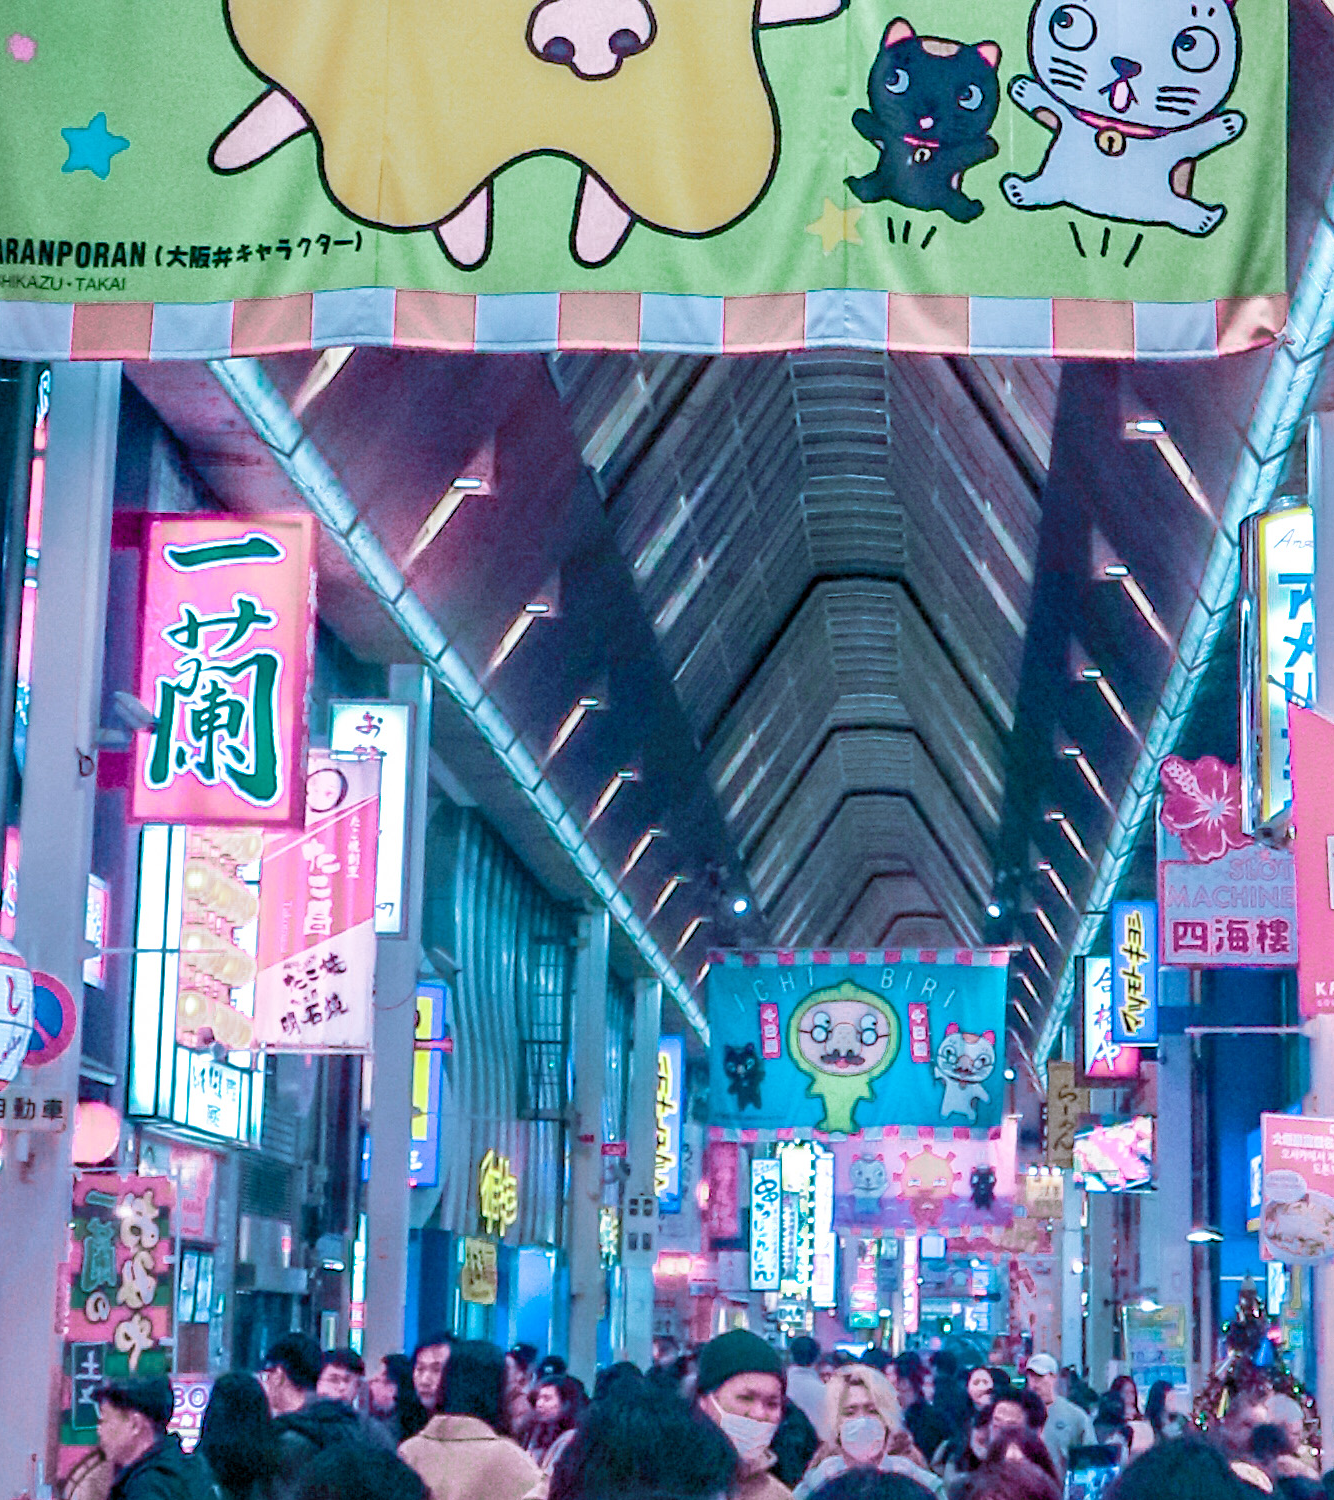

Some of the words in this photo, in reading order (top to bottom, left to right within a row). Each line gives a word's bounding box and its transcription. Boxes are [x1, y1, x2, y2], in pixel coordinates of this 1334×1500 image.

[147, 533, 286, 807] 一蘭
[1168, 884, 1296, 908] MACHINE
[733, 966, 815, 1013] ICHI
[880, 968, 956, 1009] BIRI
